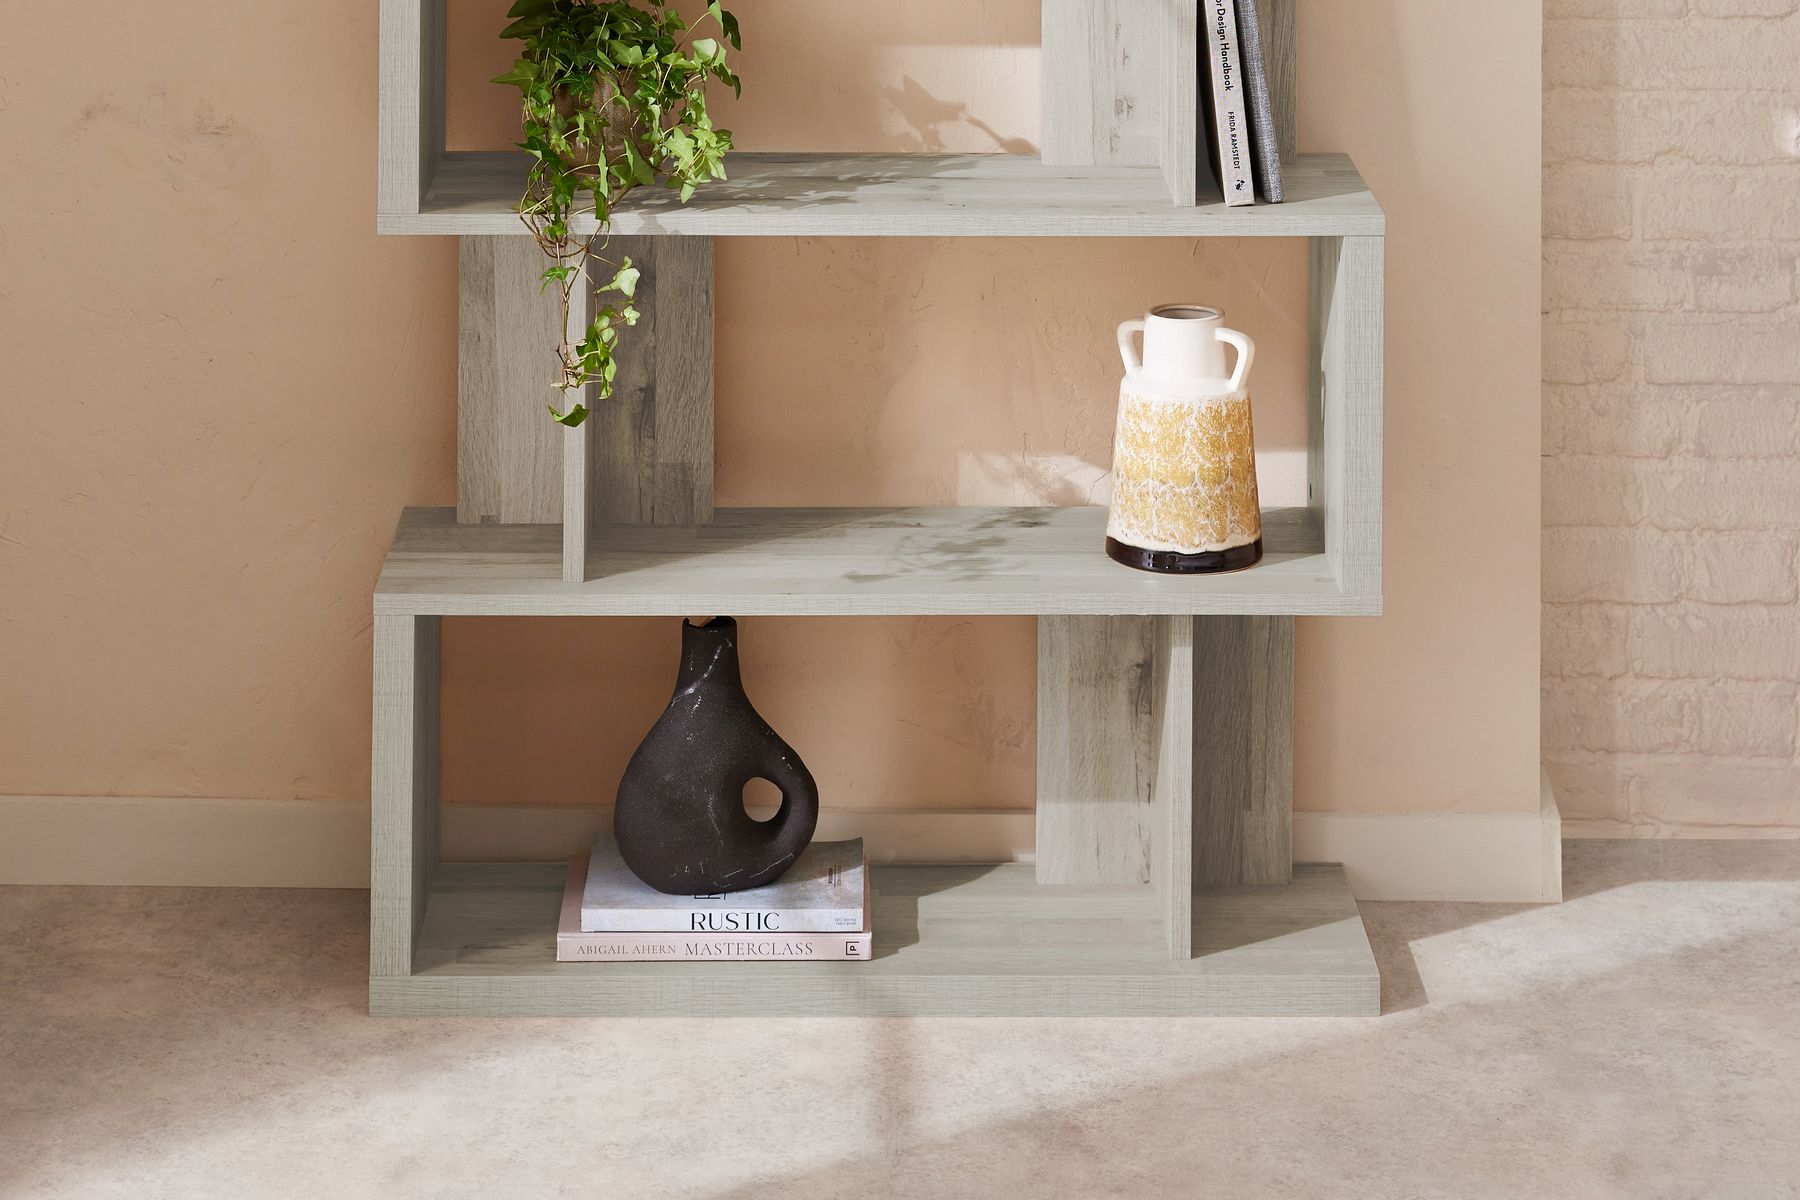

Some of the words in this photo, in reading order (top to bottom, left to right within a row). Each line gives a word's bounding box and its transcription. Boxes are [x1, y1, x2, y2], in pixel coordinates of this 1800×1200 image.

[1217, 8, 1227, 41] Design
[1220, 42, 1234, 92] Handbook
[1228, 111, 1236, 132] FRIDA
[1230, 133, 1241, 170] RAMSTEDT
[691, 912, 780, 931] RUSTIC
[577, 945, 629, 955] ABIGAIL
[632, 945, 677, 955] AHERN
[685, 942, 814, 956] MASTERCLASS
